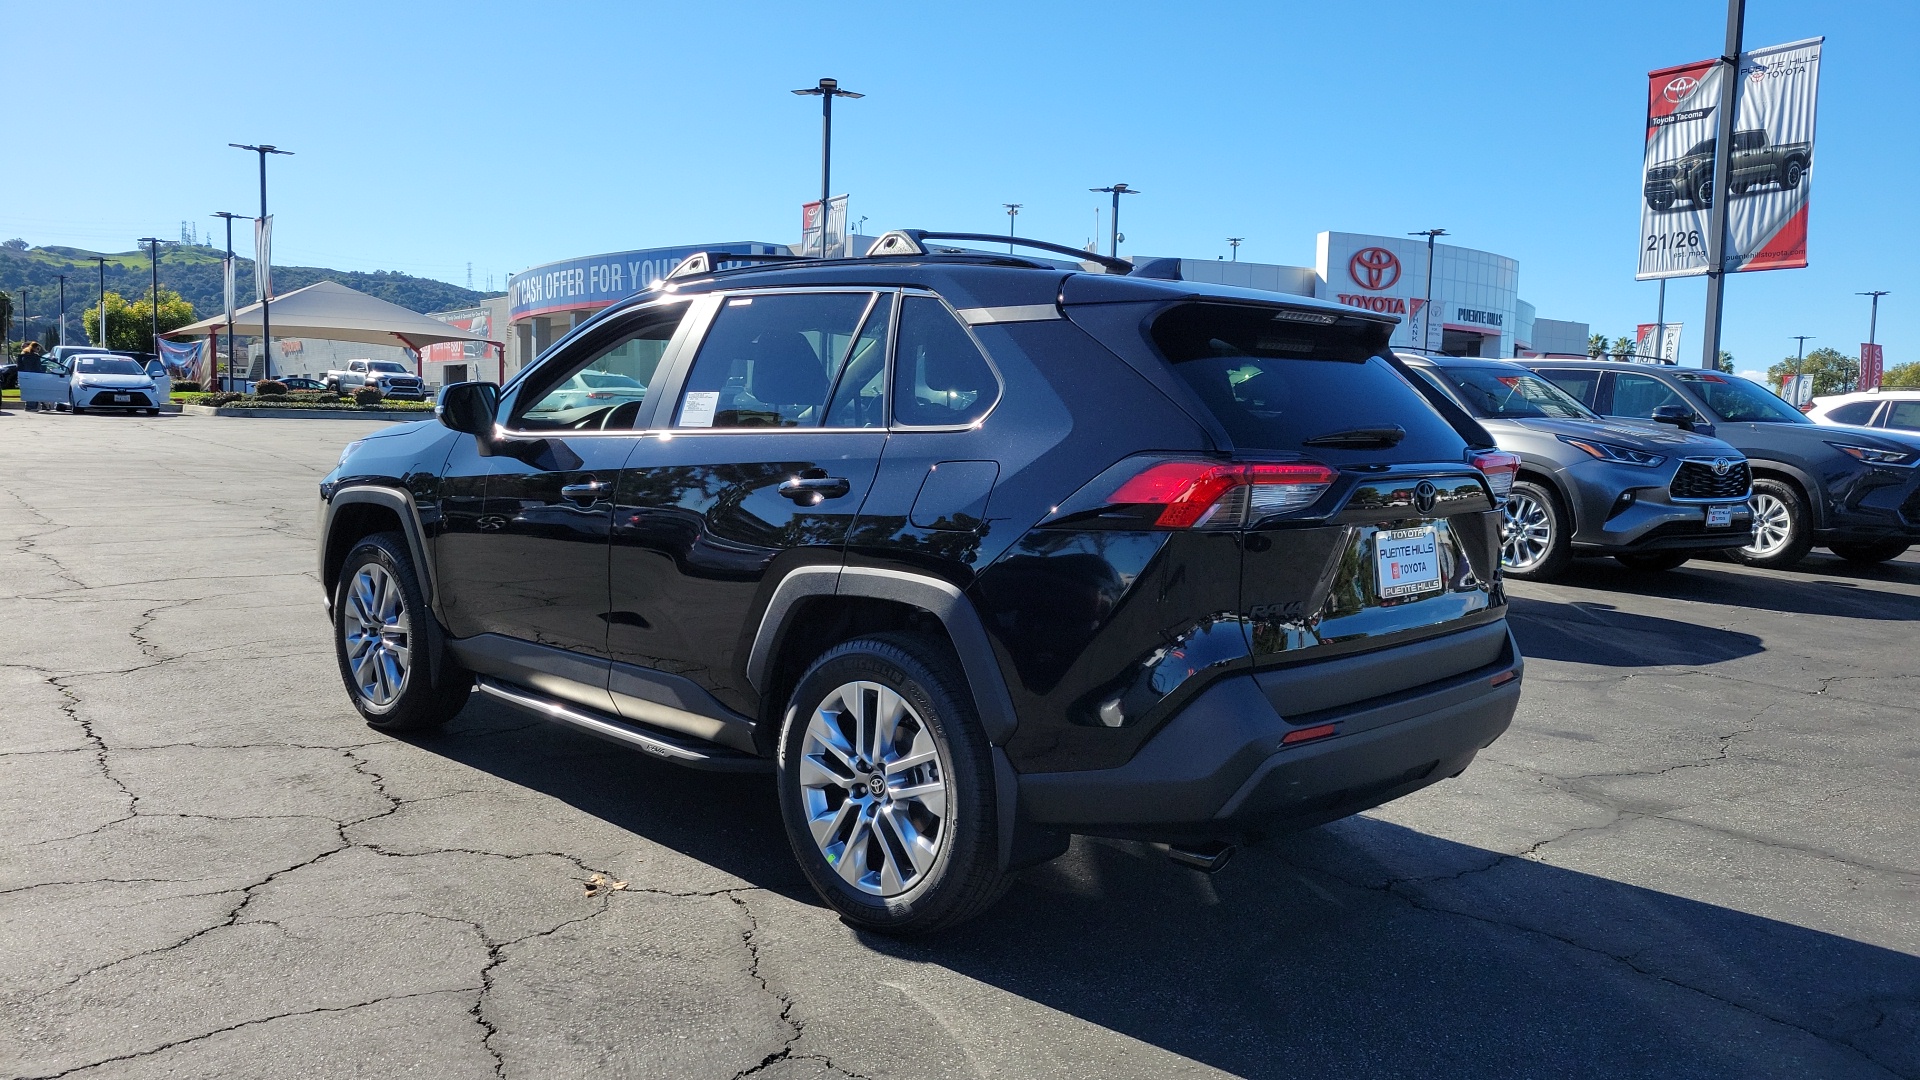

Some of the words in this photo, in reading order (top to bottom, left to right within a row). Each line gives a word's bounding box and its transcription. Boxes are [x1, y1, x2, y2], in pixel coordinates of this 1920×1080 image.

[1740, 60, 1785, 76] PUENTE
[1789, 54, 1819, 66] HILLS
[1767, 66, 1806, 79] TOYOTA
[1652, 115, 1675, 126] Toyota
[1676, 111, 1703, 121] Tacoma
[1646, 229, 1699, 252] 21/26
[1673, 250, 1688, 259] est.
[1689, 249, 1706, 258] mpg
[1725, 249, 1806, 262] puentehillstoyota.com
[521, 275, 543, 305] CASH
[545, 268, 584, 300] OFFER
[590, 263, 622, 294] FOR
[1337, 293, 1407, 315] TOYOTA
[1457, 307, 1487, 324] PUENTE
[1487, 311, 1503, 327] HILLS
[1665, 332, 1674, 360] PARK
[1873, 348, 1881, 387] OYOTA
[1391, 528, 1424, 540] TOYOTA
[1379, 545, 1412, 560] PUENTE
[1412, 542, 1434, 556] HILLS
[1400, 561, 1427, 575] TOYOTA
[1385, 582, 1418, 597] PUENTE
[1417, 580, 1440, 594] HILLS
